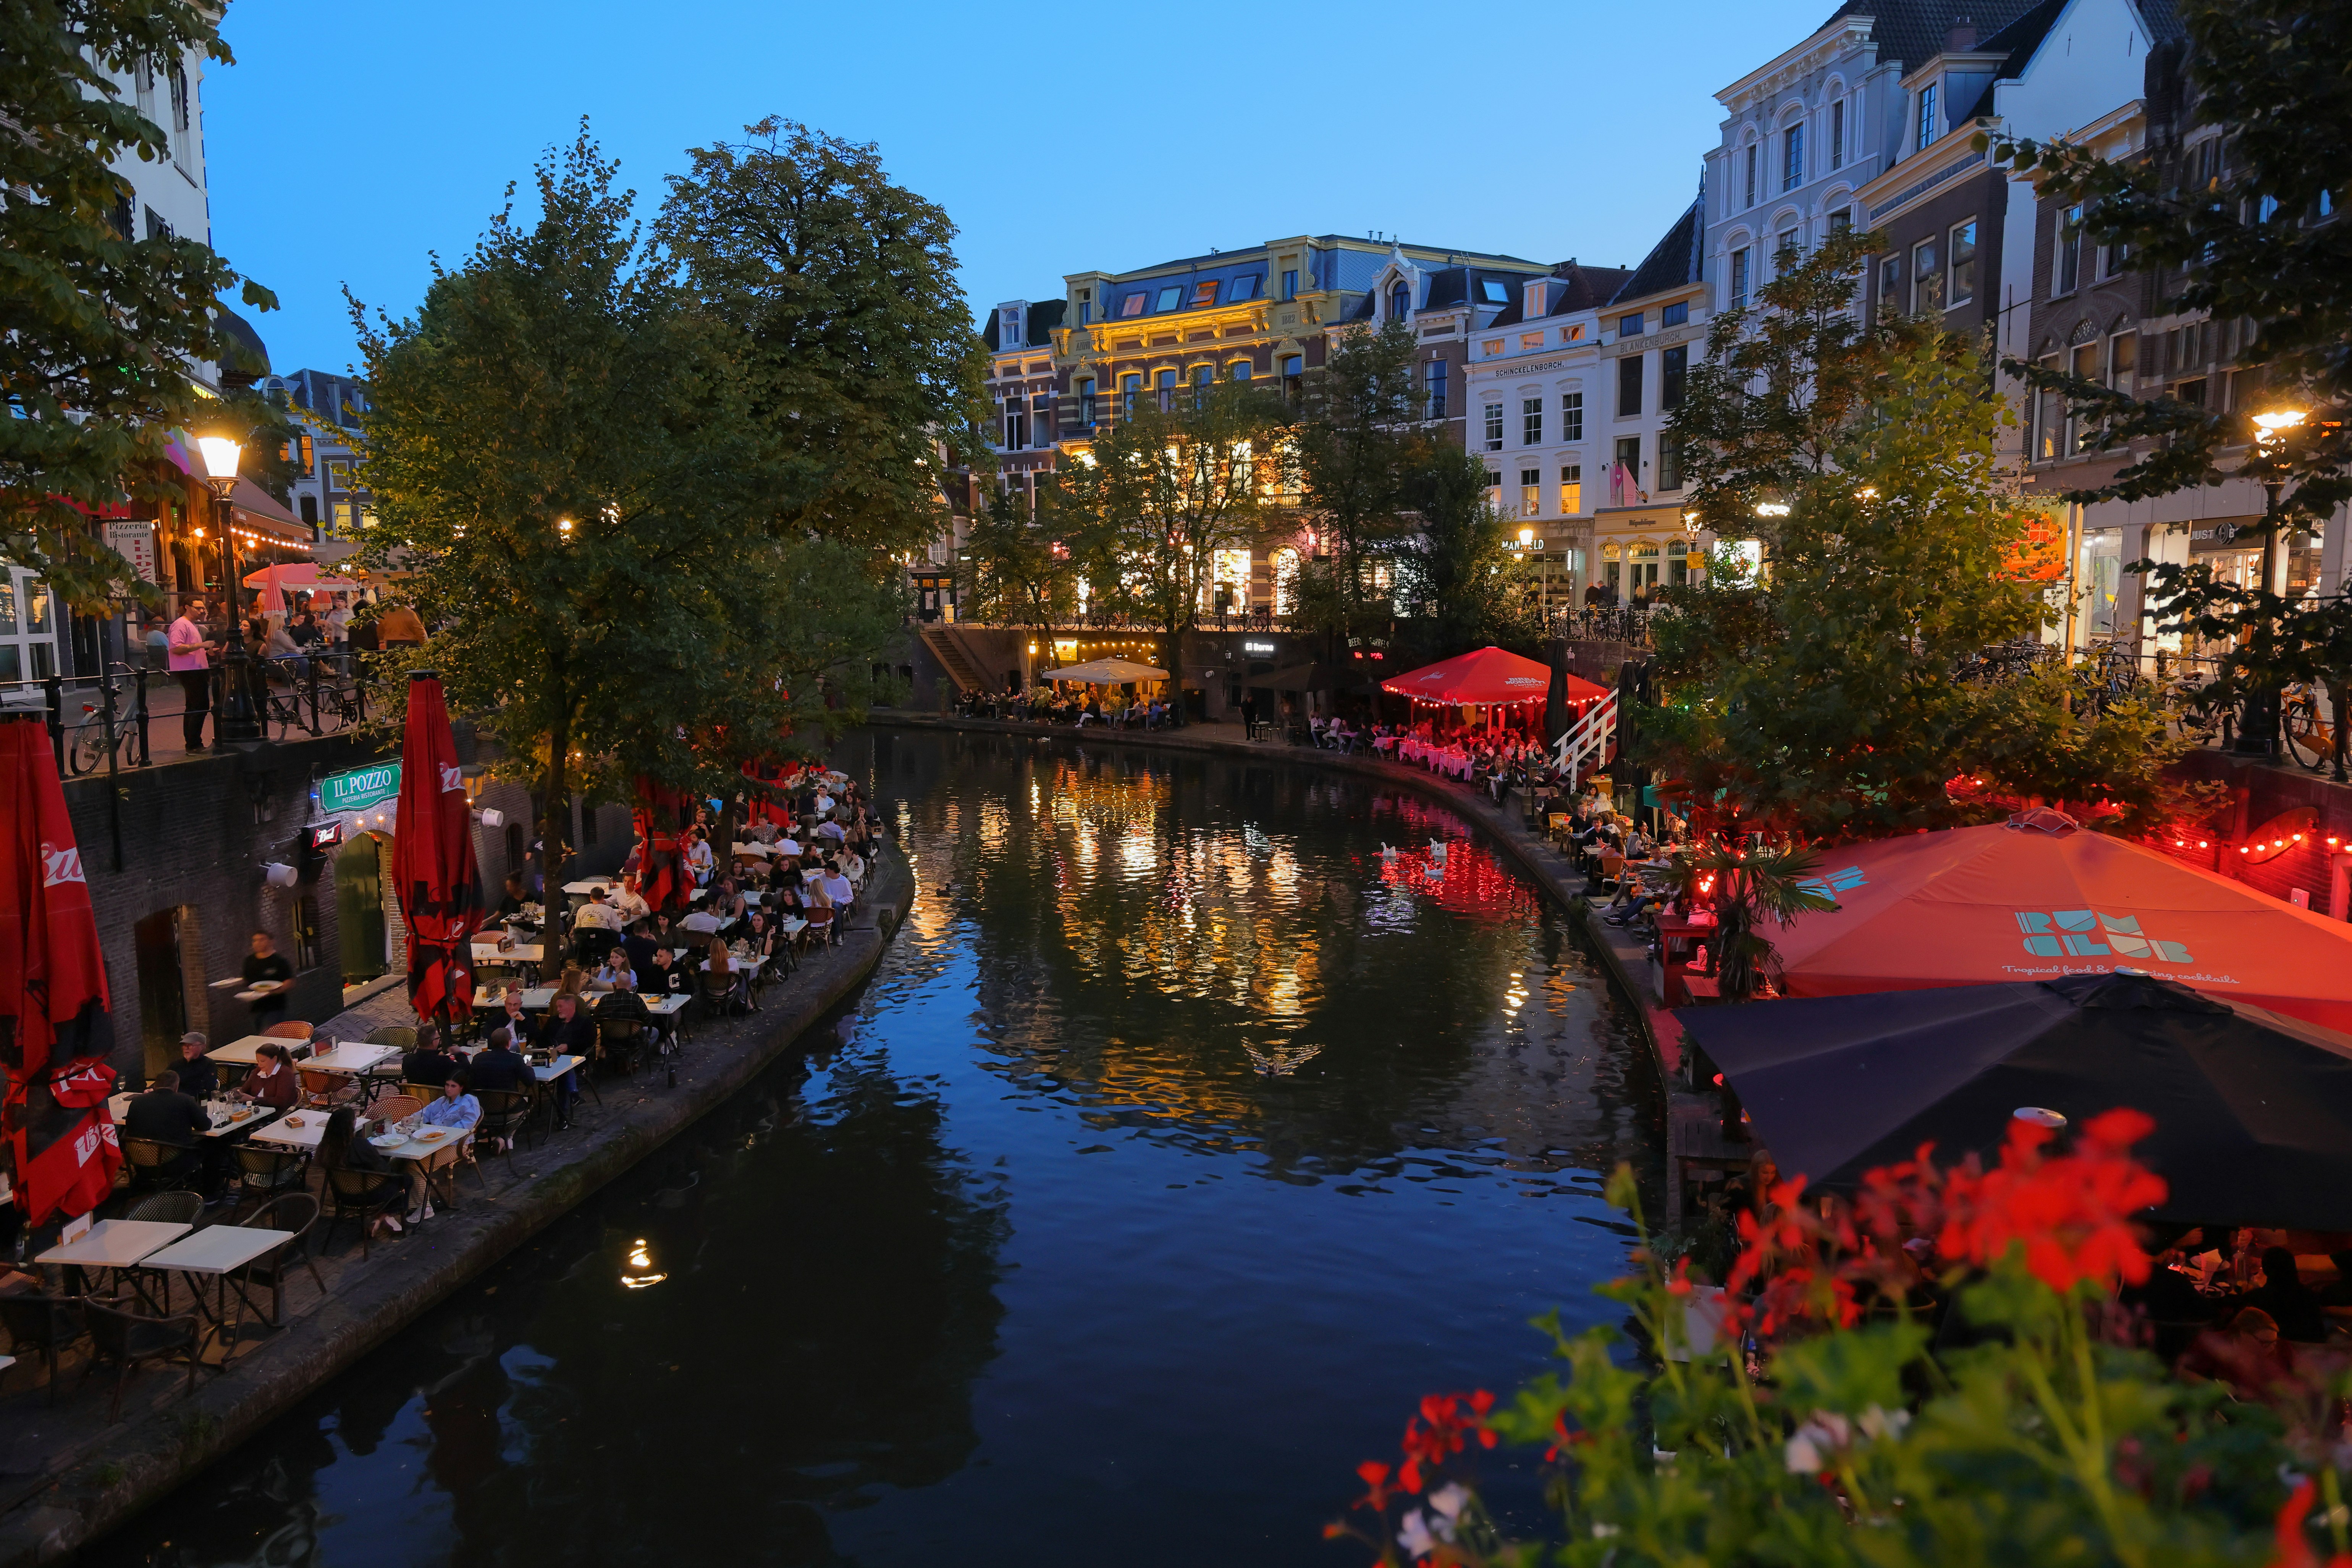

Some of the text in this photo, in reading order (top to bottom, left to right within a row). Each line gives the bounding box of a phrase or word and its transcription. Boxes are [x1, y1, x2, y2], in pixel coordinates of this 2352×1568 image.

[1281, 314, 1295, 325] 1882
[1076, 341, 1090, 351] ANNO
[1495, 361, 1565, 377] SCHINCKELENBORCH.
[109, 522, 148, 530] Pizzeria
[2190, 529, 2214, 540] JUST
[333, 769, 392, 798] IL POZZO
[342, 788, 386, 804] PIZZERIA RISTORANTE
[317, 828, 335, 843] Bud
[2014, 909, 2145, 936] RUM
[2023, 934, 2194, 963] CLUB
[2001, 965, 2061, 976] Tropical
[2096, 965, 2110, 973] &
[2177, 973, 2240, 984] cocktails
